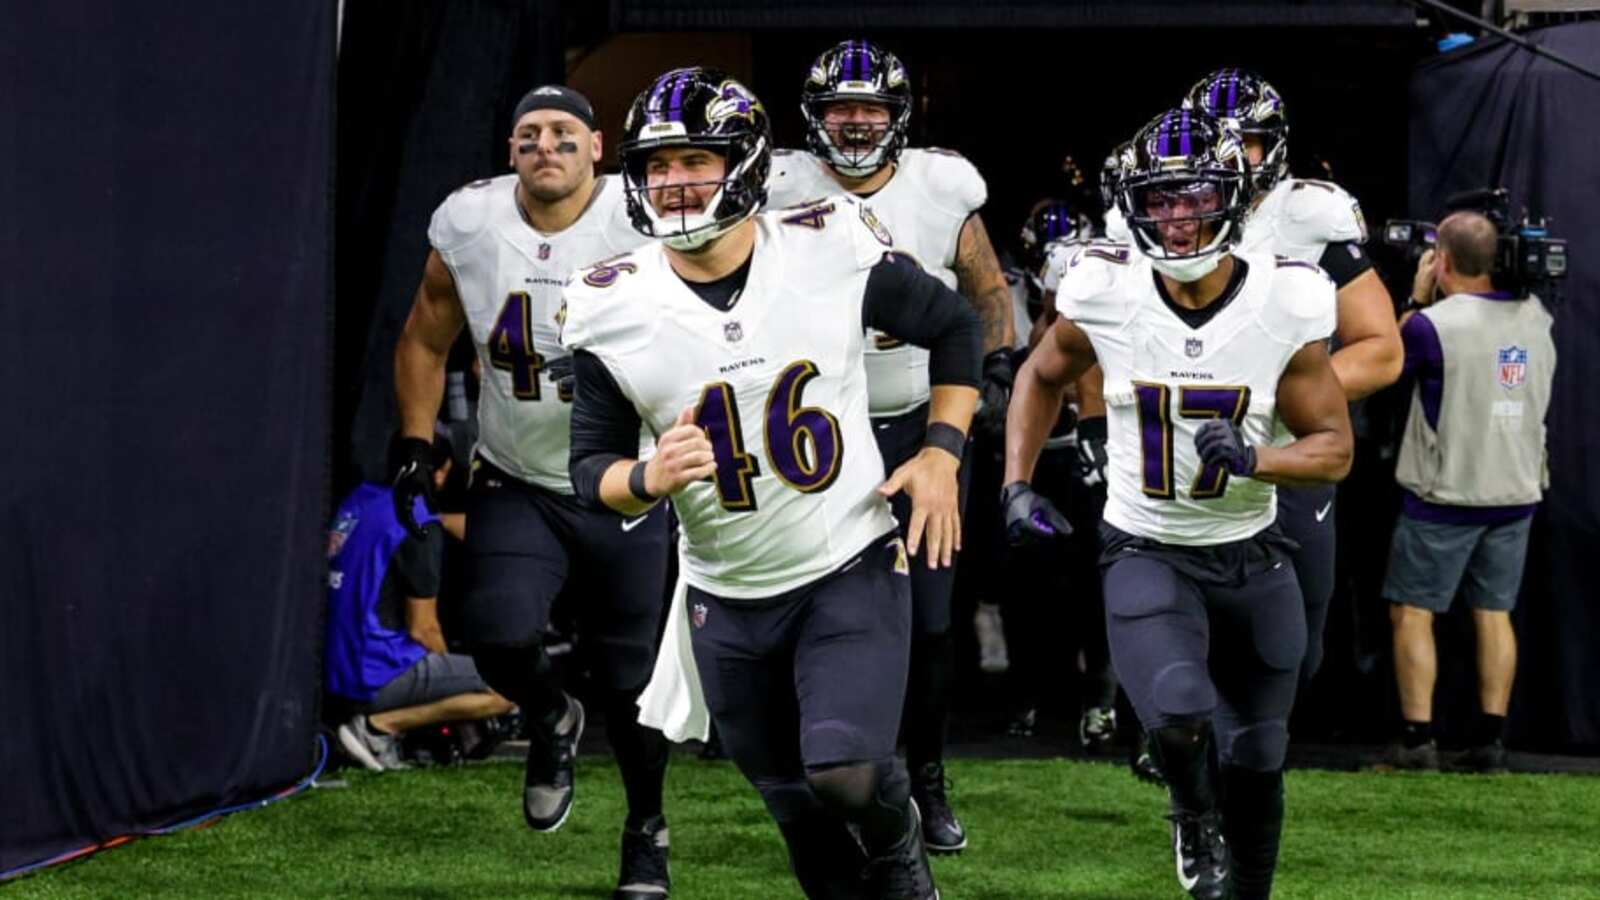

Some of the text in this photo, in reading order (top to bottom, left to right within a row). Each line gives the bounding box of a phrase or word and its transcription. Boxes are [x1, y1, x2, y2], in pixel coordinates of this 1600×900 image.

[720, 357, 765, 373] RAVENS
[1170, 371, 1214, 379] RAVENS
[693, 359, 844, 512] 46
[1131, 379, 1251, 500] 17
